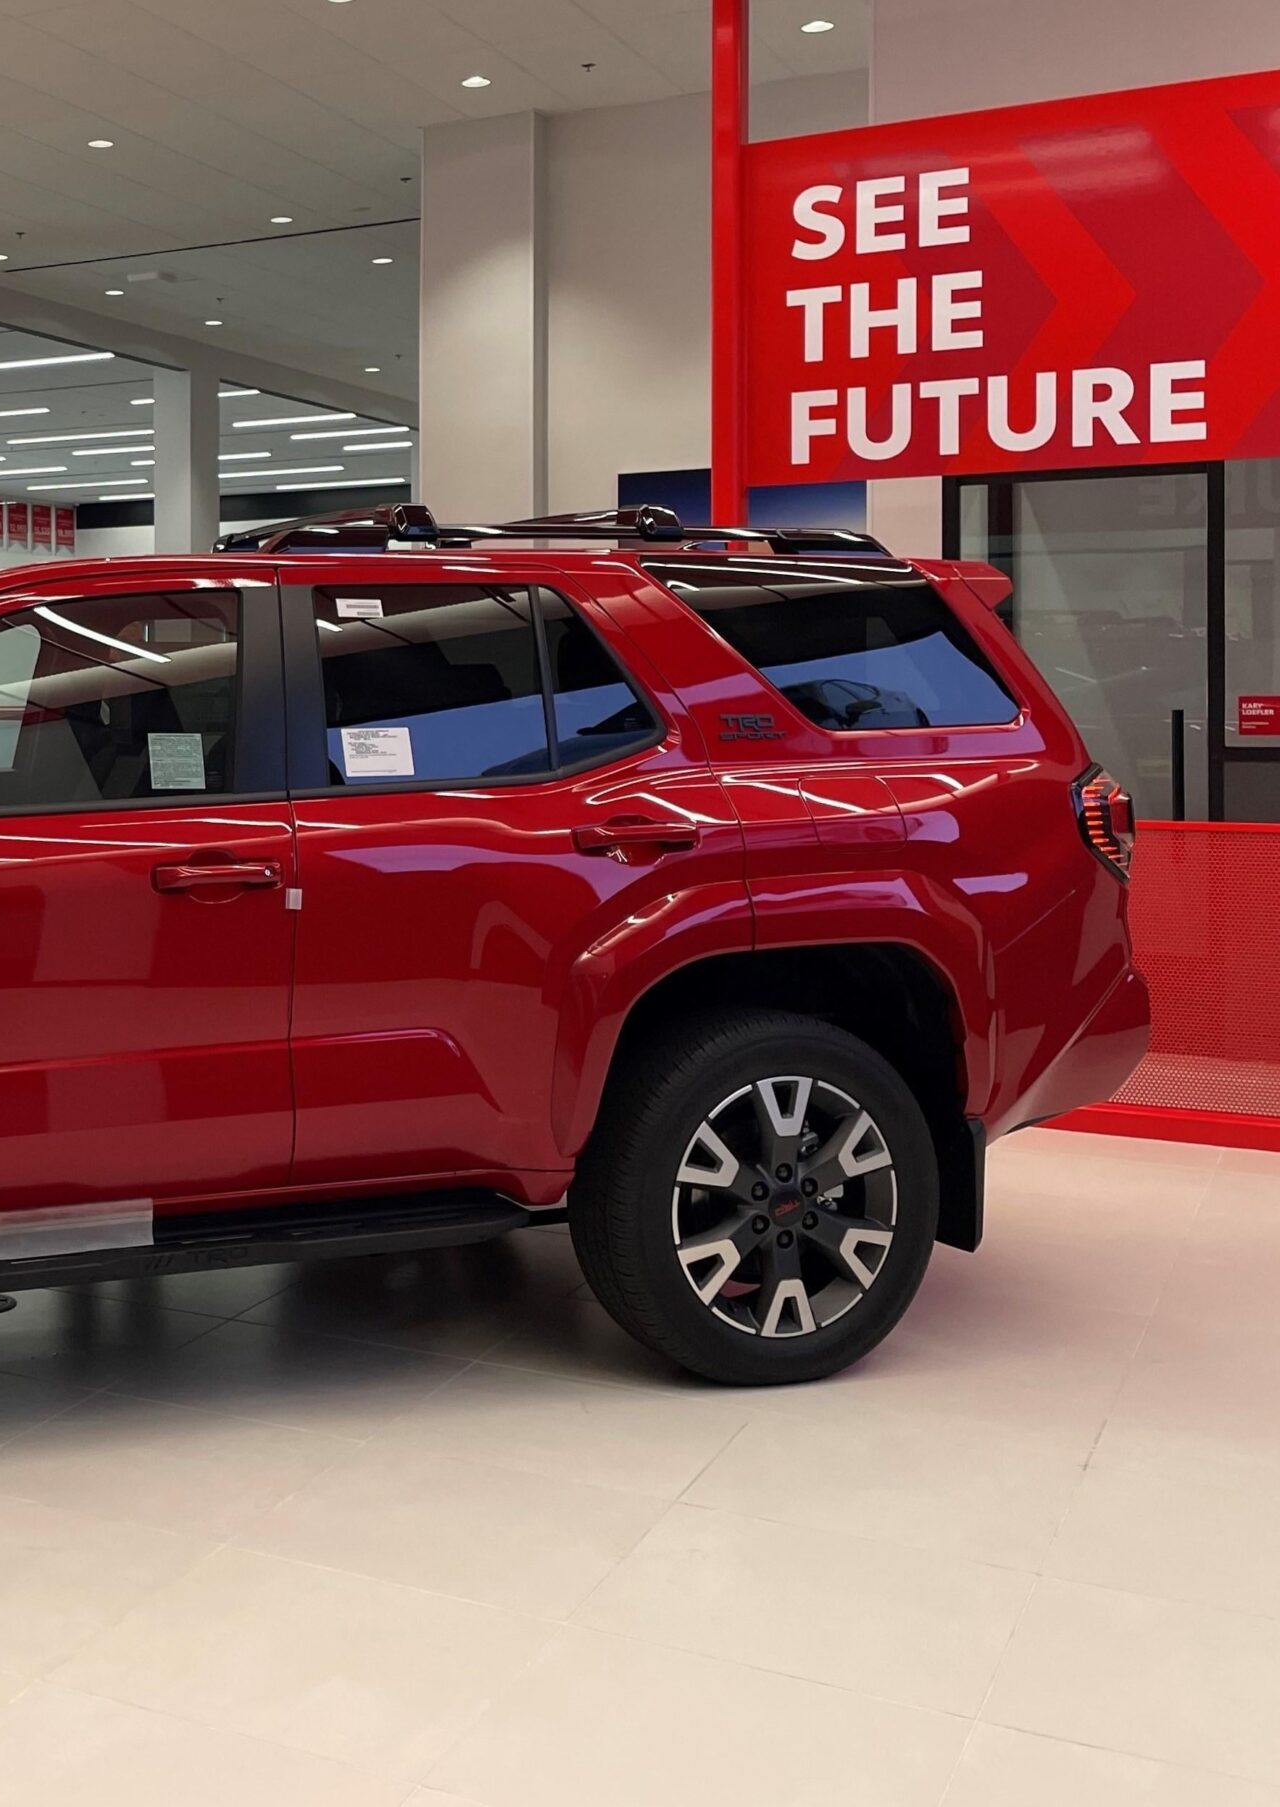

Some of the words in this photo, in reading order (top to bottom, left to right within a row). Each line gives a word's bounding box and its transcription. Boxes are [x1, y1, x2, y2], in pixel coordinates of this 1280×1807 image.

[791, 167, 970, 261] SEE
[786, 270, 984, 363] THE
[790, 359, 1208, 464] FUTURE
[719, 713, 775, 732] TRD
[719, 731, 785, 741] SPORT
